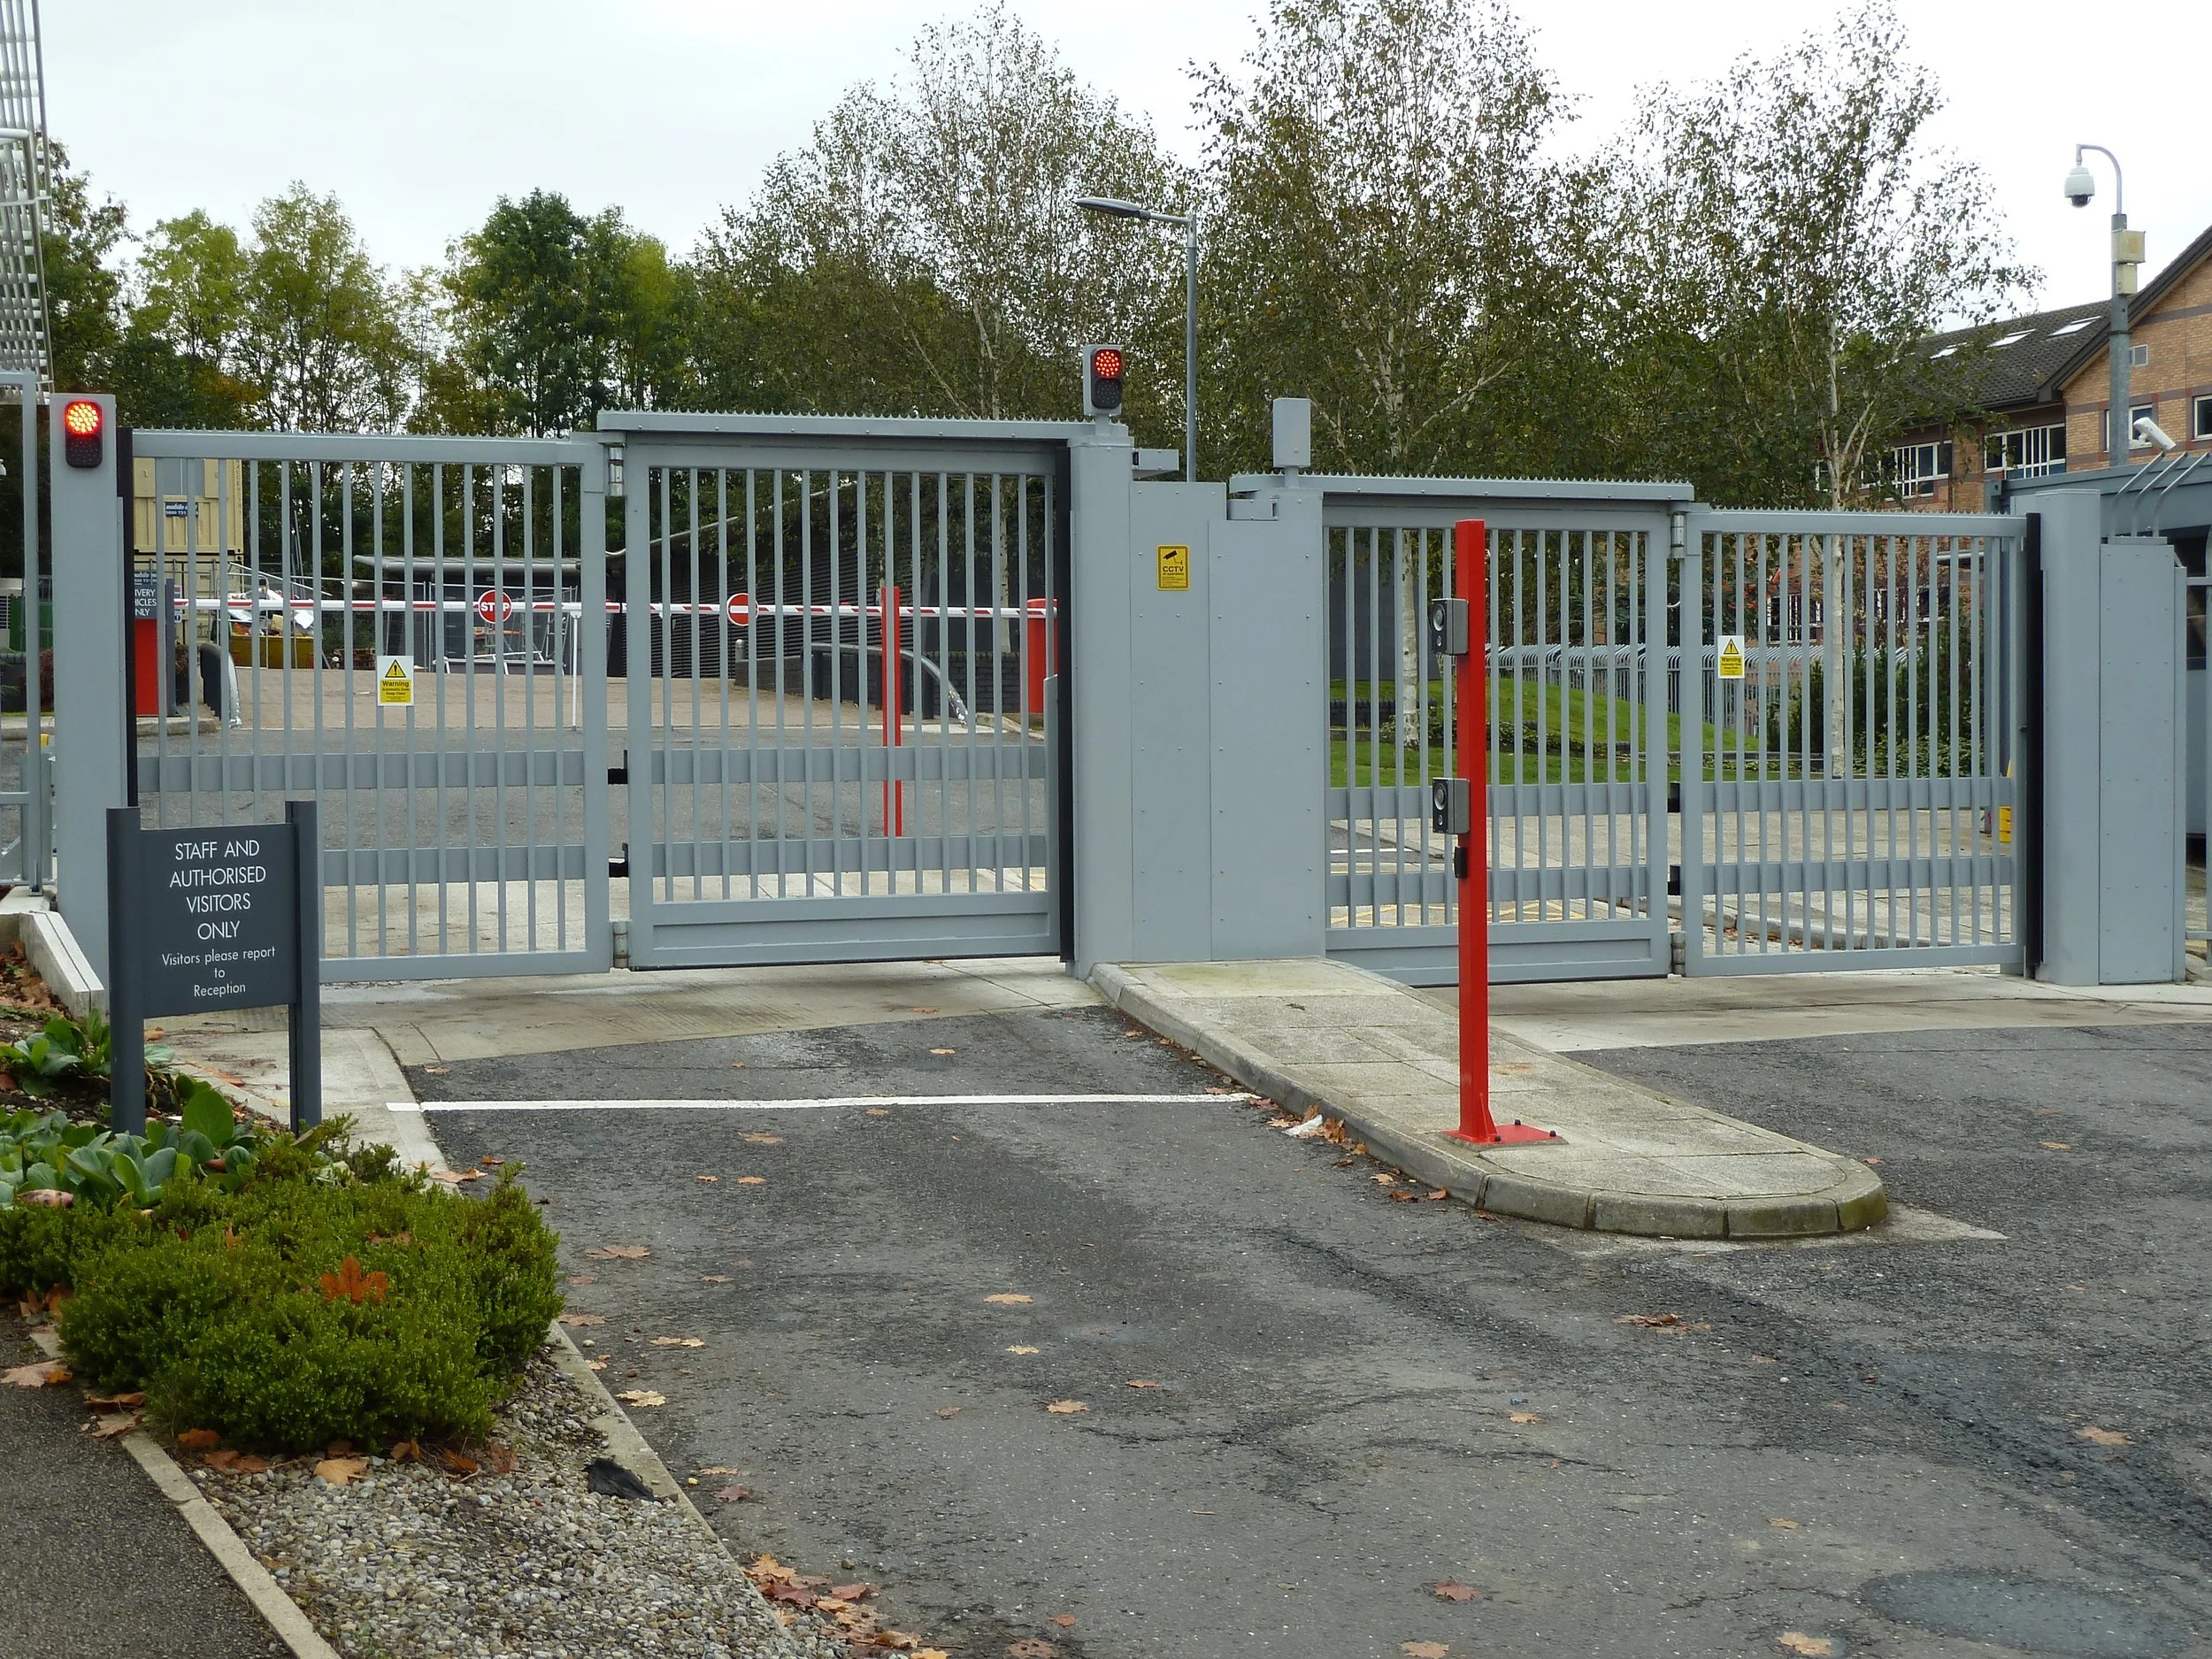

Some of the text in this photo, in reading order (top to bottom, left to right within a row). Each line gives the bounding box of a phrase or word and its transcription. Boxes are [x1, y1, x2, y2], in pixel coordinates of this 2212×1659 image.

[134, 588, 156, 597] IVERY
[480, 602, 511, 612] STP
[175, 840, 259, 860] STAFF AND
[169, 865, 266, 888] AUTHORISED
[186, 893, 251, 913] VISITORS
[197, 920, 240, 940] ONLY
[161, 946, 275, 966] Visitors please report
[214, 968, 226, 979] to
[194, 980, 246, 998] Reception
